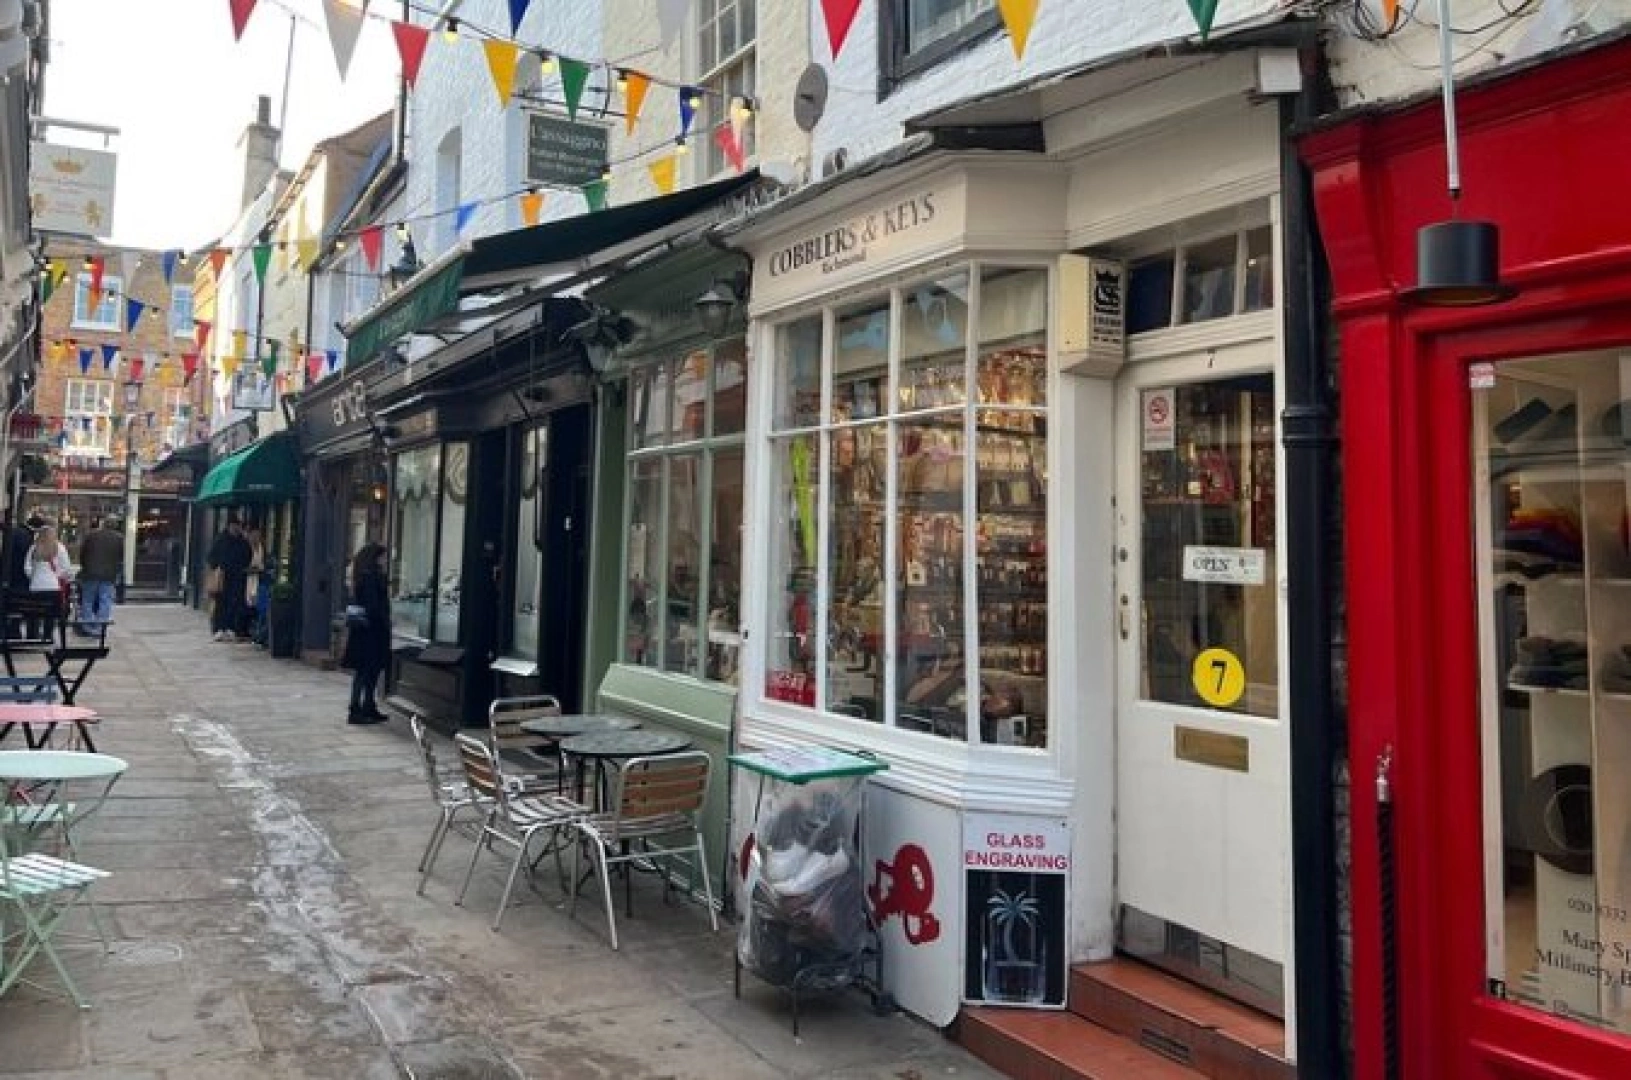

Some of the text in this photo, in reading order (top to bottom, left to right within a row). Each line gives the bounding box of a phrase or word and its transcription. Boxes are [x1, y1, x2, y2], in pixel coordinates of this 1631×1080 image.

[768, 190, 936, 277] COBBLERS & KEYS
[1206, 349, 1217, 368] 7
[1192, 556, 1233, 572] OPEN
[1211, 660, 1227, 695] 7
[986, 832, 1045, 850] GLASS
[965, 850, 1067, 869] ENGRAVING
[1562, 929, 1606, 959] Mary
